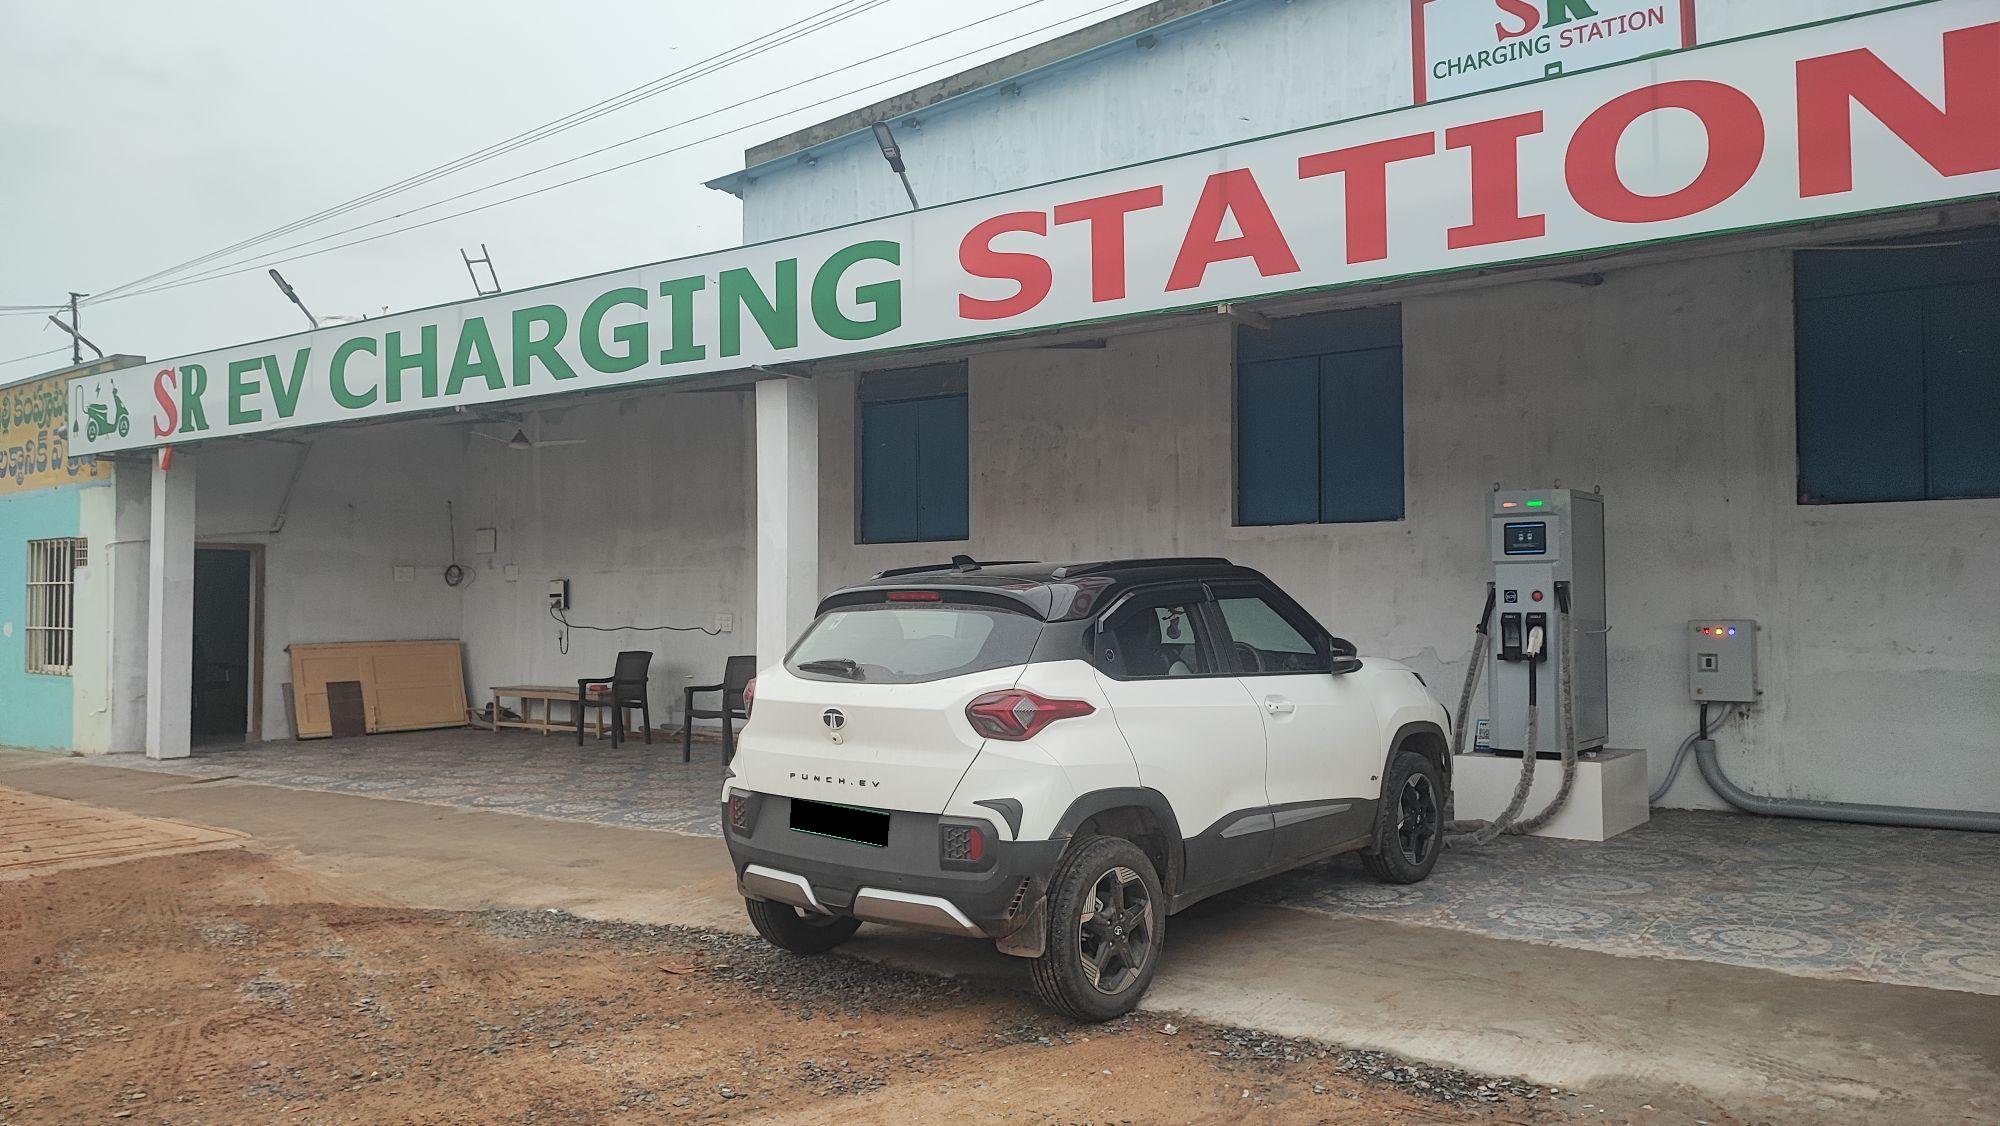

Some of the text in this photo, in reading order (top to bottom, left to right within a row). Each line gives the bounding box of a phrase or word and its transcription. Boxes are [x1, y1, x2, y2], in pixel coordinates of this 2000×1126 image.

[1433, 6, 1664, 79] CHARGING STATION
[153, 20, 2000, 439] SR EV CHARGING STATION
[789, 772, 880, 788] PUNCH.EV
